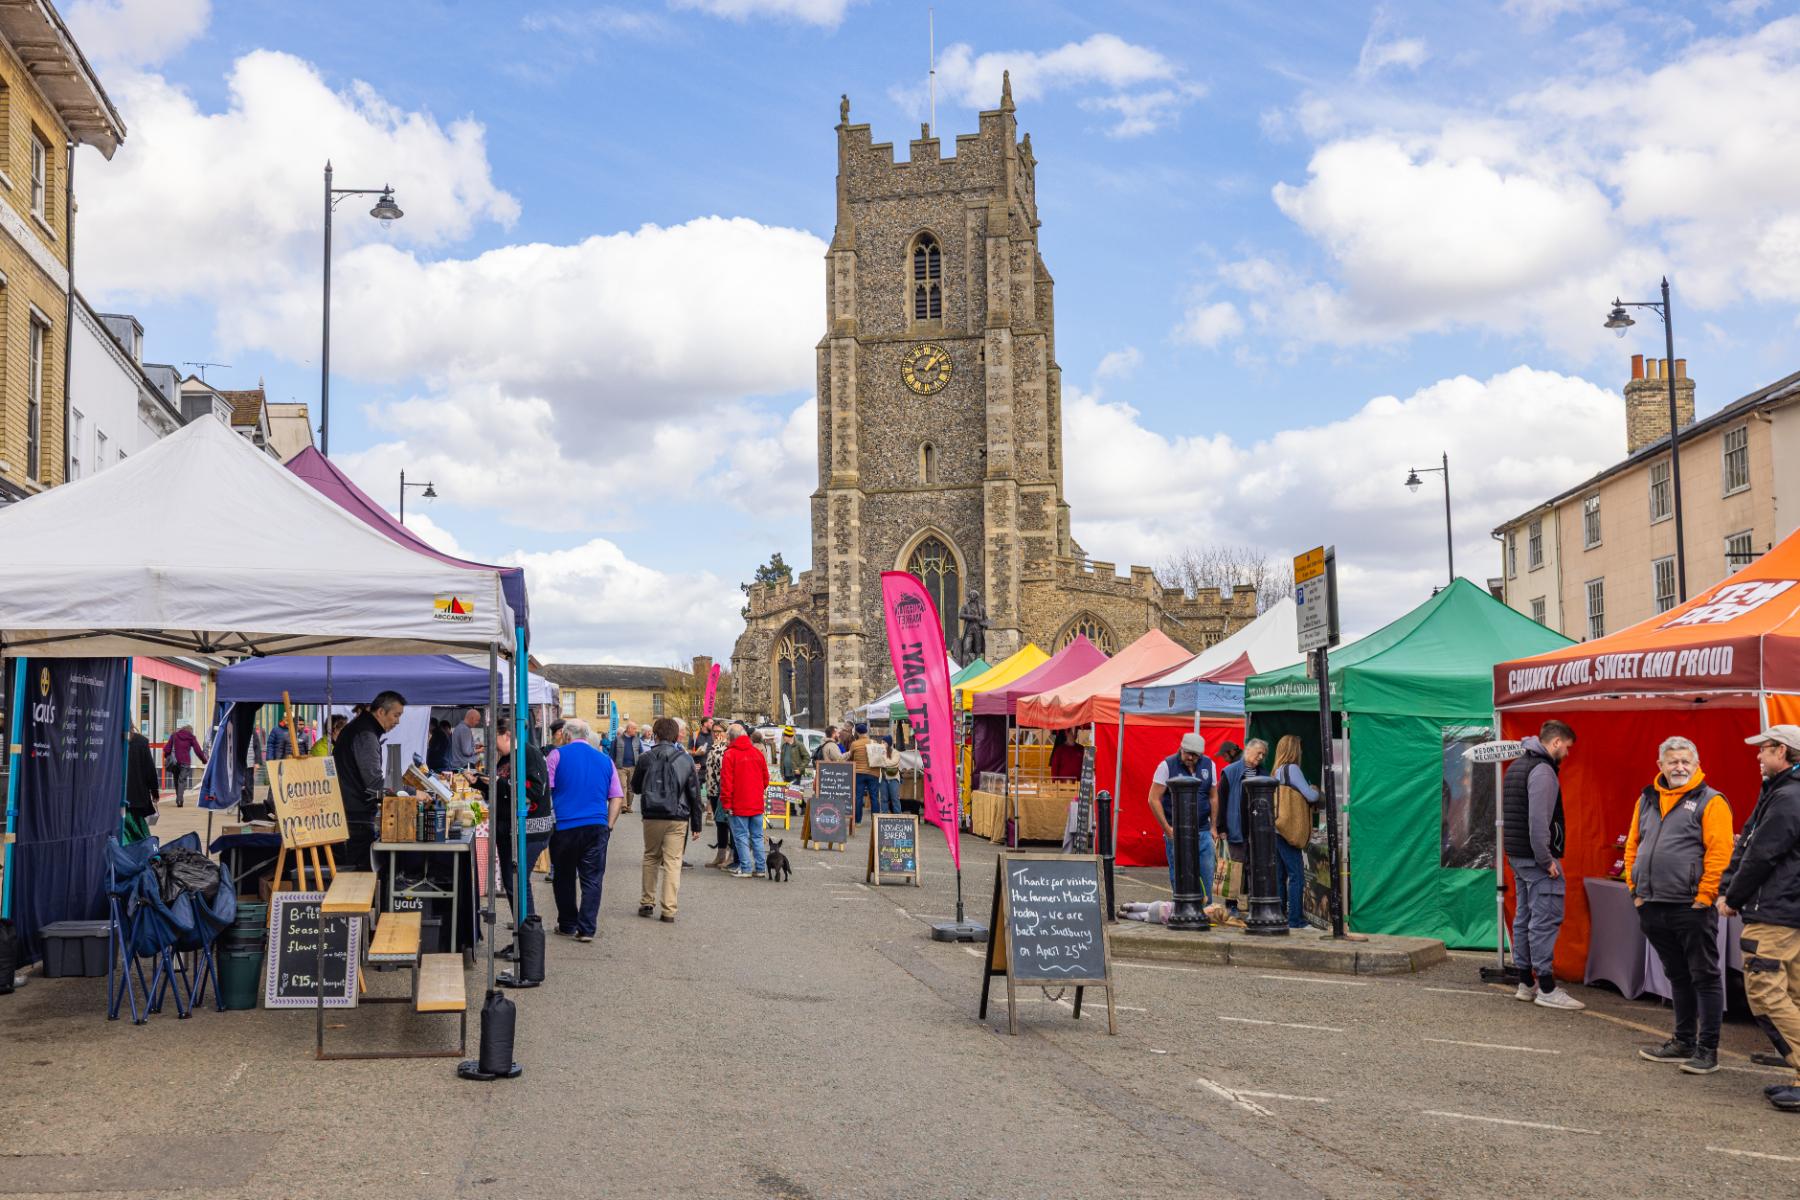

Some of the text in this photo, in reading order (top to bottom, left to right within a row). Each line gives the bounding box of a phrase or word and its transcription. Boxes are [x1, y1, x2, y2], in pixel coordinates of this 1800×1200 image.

[1508, 646, 1734, 694] CHUNKY, LOUD, SWEET AND PROUD
[1013, 867, 1098, 895] Thanks for visiting
[1062, 890, 1096, 903] Market
[394, 897, 424, 910] yau's
[290, 908, 325, 921] Briti
[1013, 906, 1039, 928] today
[1066, 912, 1084, 921] are
[288, 923, 336, 934] Seasoal
[1016, 924, 1093, 943] back in Sudbury
[287, 941, 328, 953] flowes
[1019, 947, 1031, 957] on
[1036, 944, 1059, 960] April
[291, 975, 311, 987] £15
